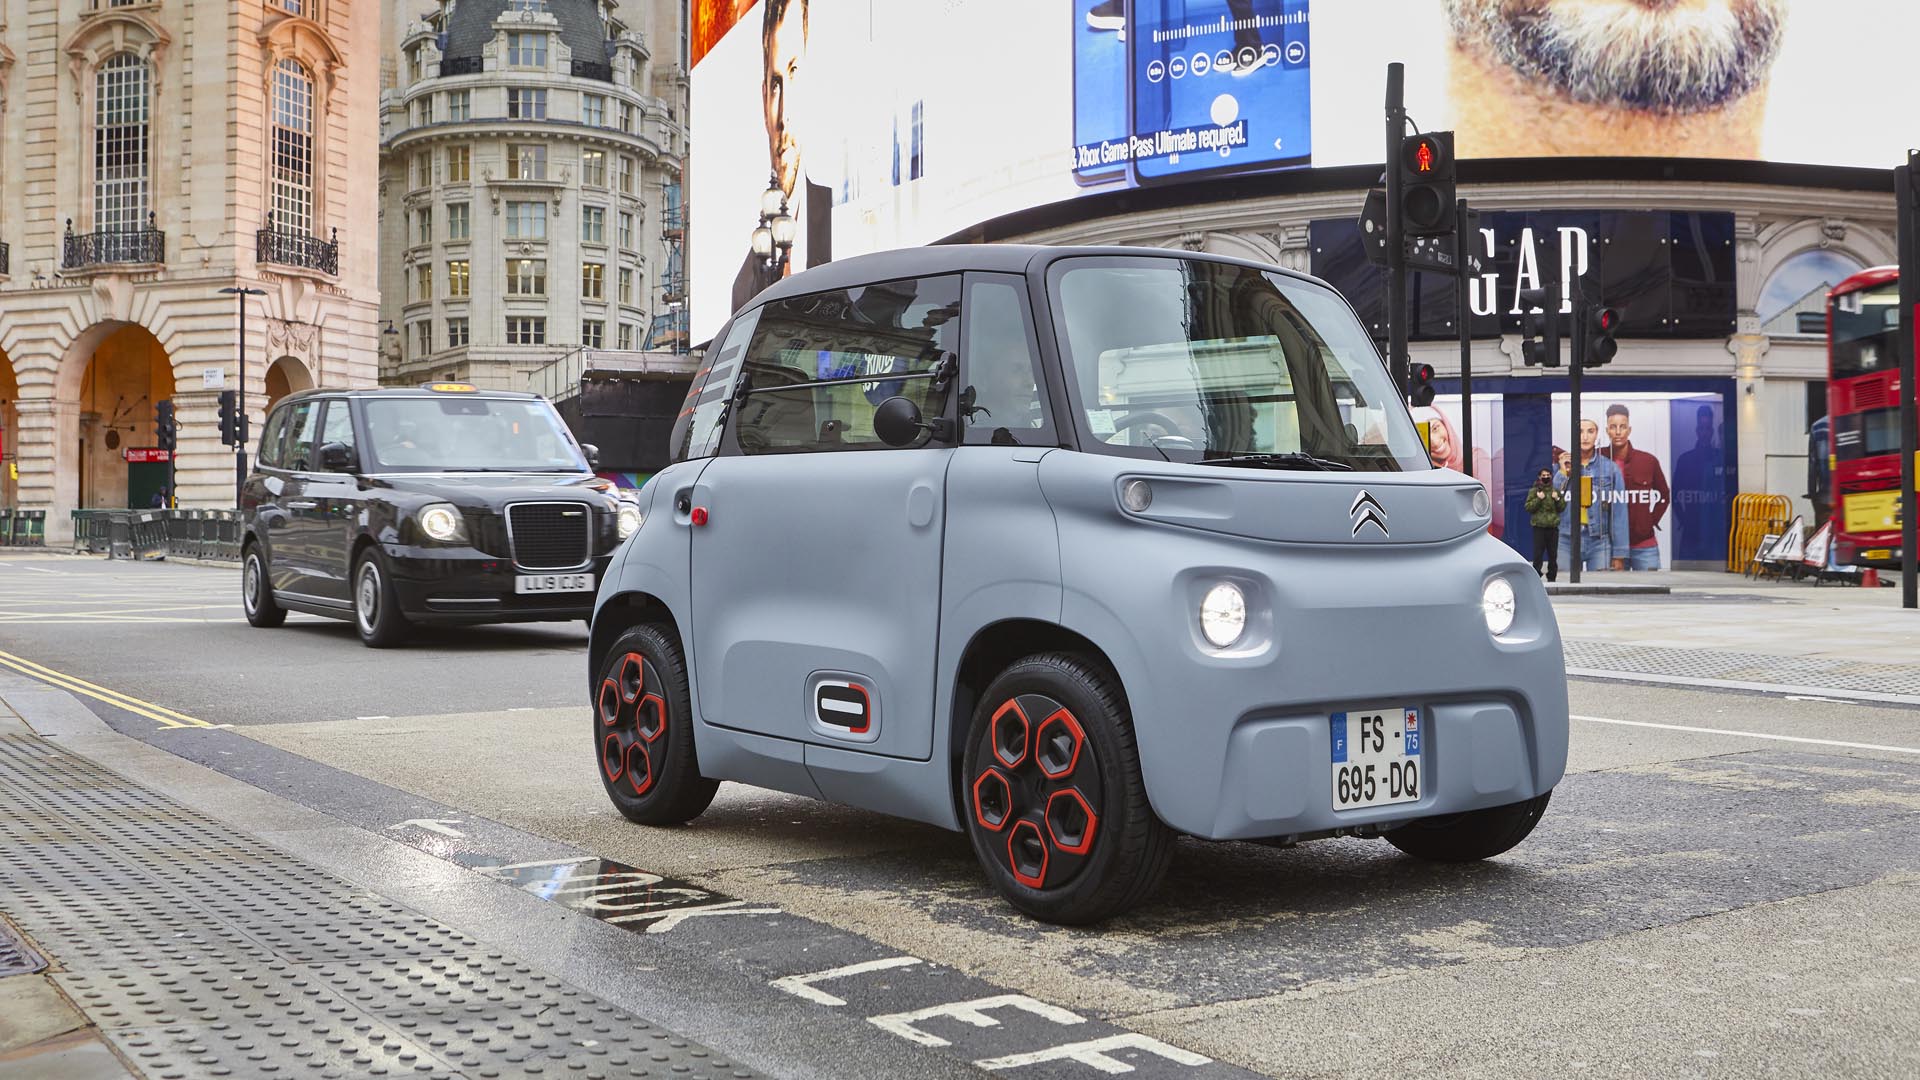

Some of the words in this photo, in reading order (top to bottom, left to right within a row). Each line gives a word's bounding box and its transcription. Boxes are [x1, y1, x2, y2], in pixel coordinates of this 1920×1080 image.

[1077, 145, 1101, 168] Xbox
[1100, 140, 1129, 164] Game
[1129, 135, 1154, 159] Pass
[1155, 128, 1197, 154] Ultimate
[1198, 120, 1247, 152] required.
[1469, 227, 1588, 315] GAP
[1601, 489, 1666, 504] UNITED.
[1337, 739, 1343, 750] F
[1406, 734, 1418, 750] 75
